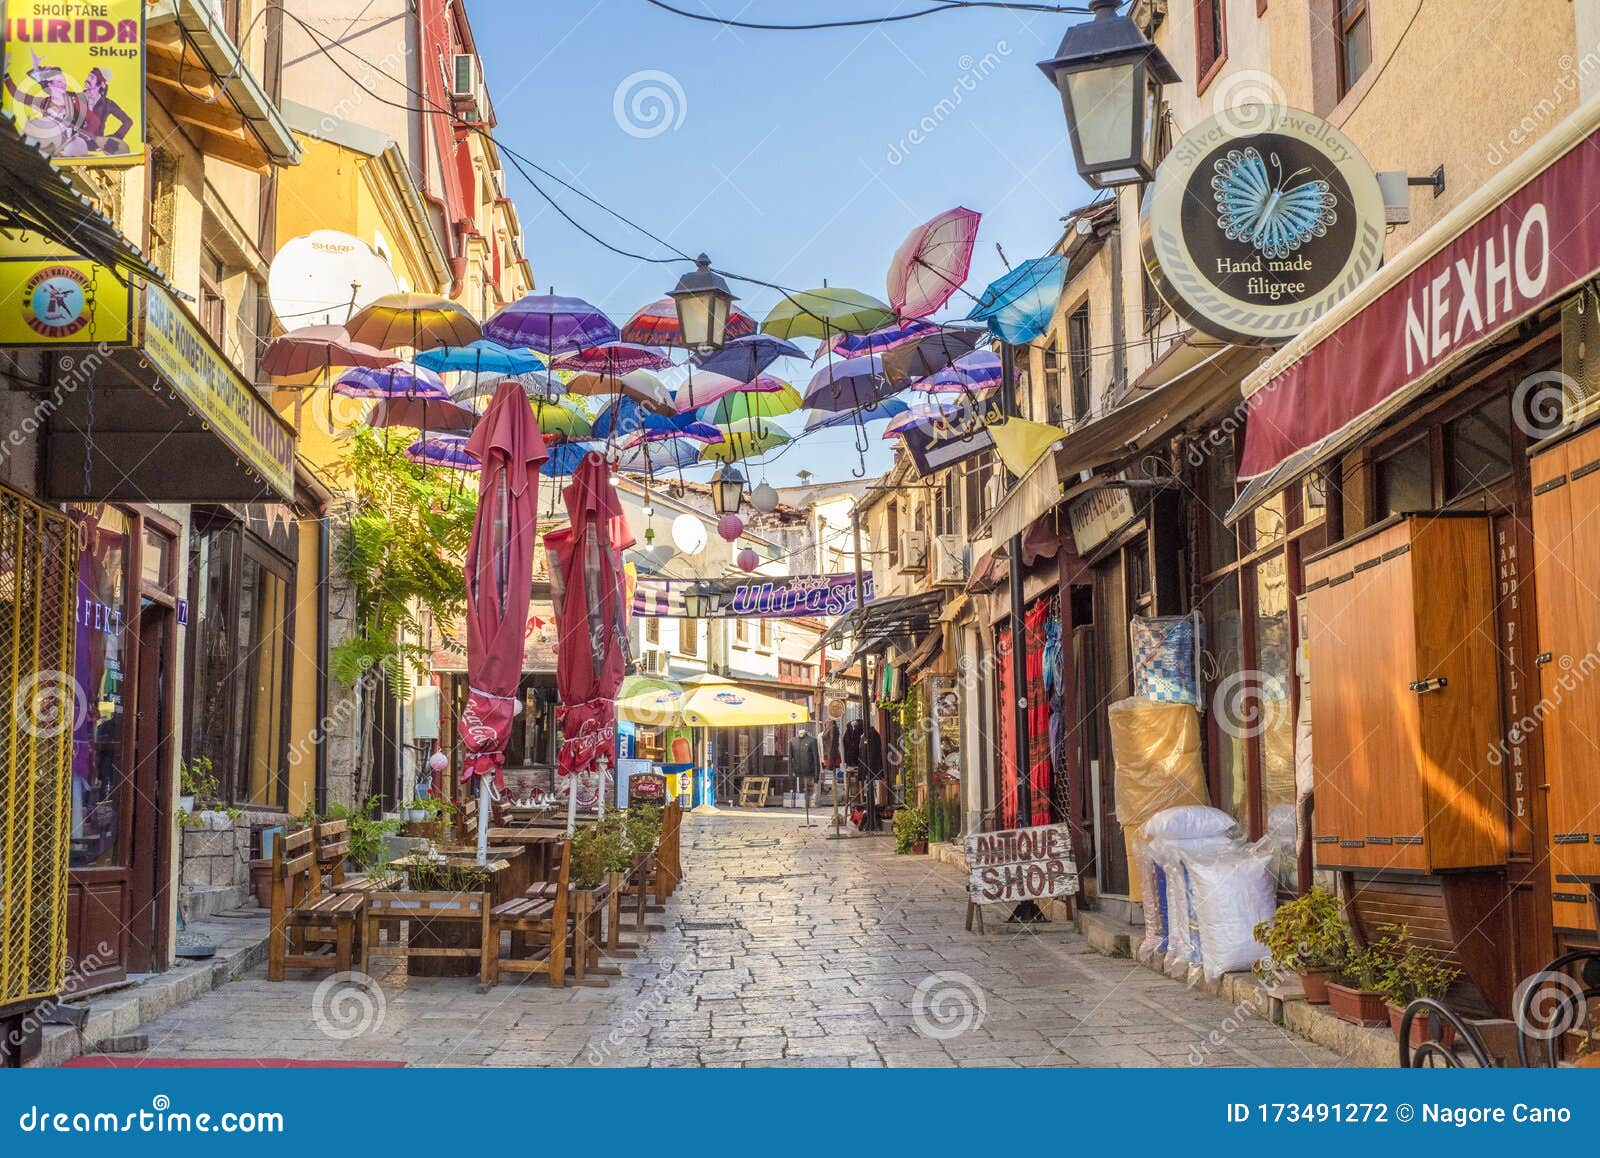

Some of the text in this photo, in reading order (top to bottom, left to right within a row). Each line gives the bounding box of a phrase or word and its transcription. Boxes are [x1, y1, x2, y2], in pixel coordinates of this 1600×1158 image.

[33, 4, 108, 17] SHQIPTARE
[5, 17, 138, 44] ILIRIDA
[88, 46, 138, 59] Shkup
[311, 242, 355, 253] SHARP
[1216, 257, 1313, 274] Hand made
[1247, 277, 1306, 299] filigree
[1404, 202, 1550, 375] NEXHO
[250, 399, 293, 473] ILIRIDA
[975, 828, 1059, 865] ANTIQUE
[981, 859, 1065, 901] SHOP
